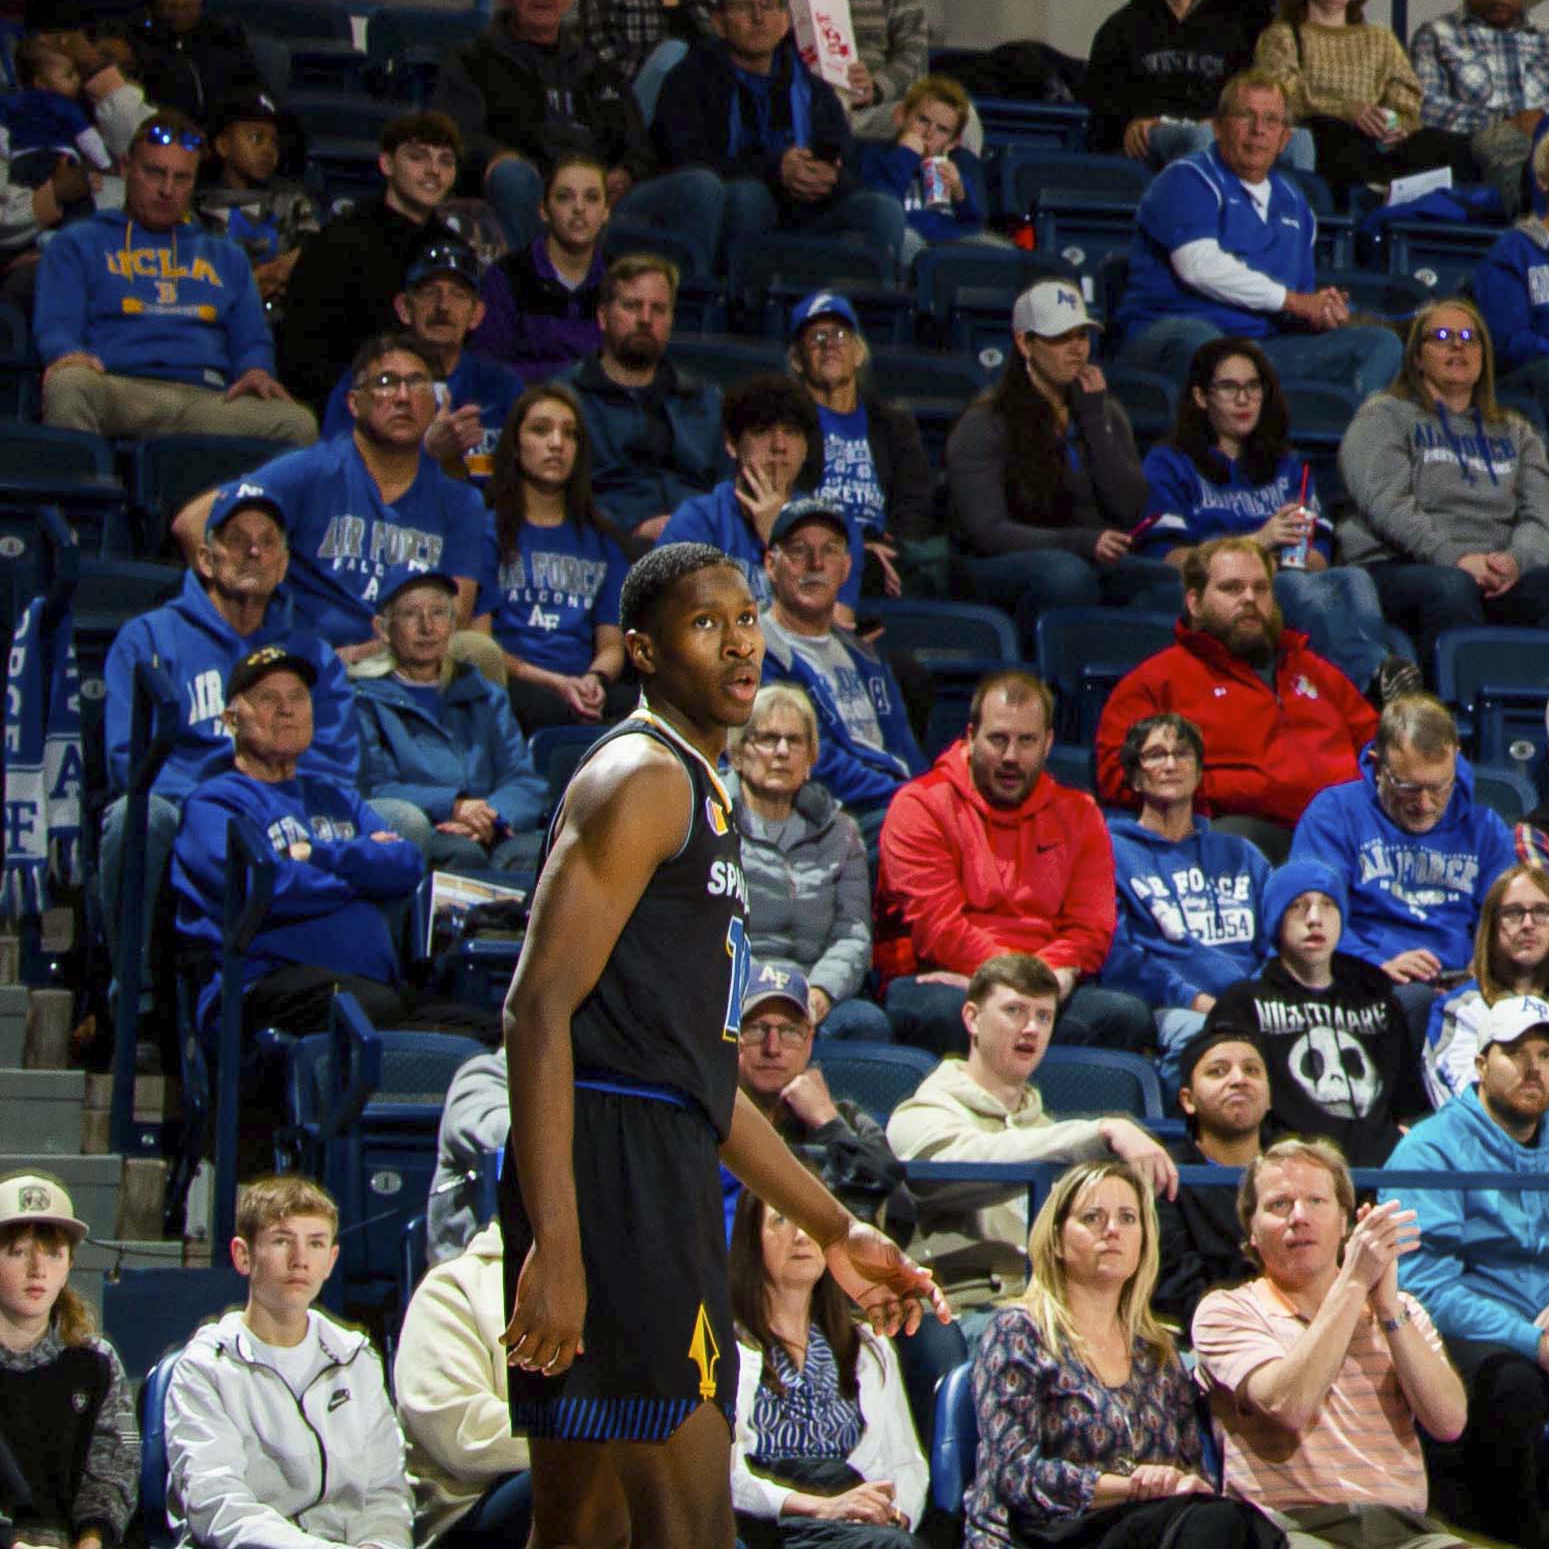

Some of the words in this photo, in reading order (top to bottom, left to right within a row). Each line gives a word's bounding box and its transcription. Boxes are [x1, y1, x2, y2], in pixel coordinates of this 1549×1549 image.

[106, 247, 223, 287] UCLA
[317, 514, 365, 558] AIR
[508, 588, 594, 610] ALCONS
[1172, 867, 1250, 900] FOCE
[757, 966, 788, 990] AF
